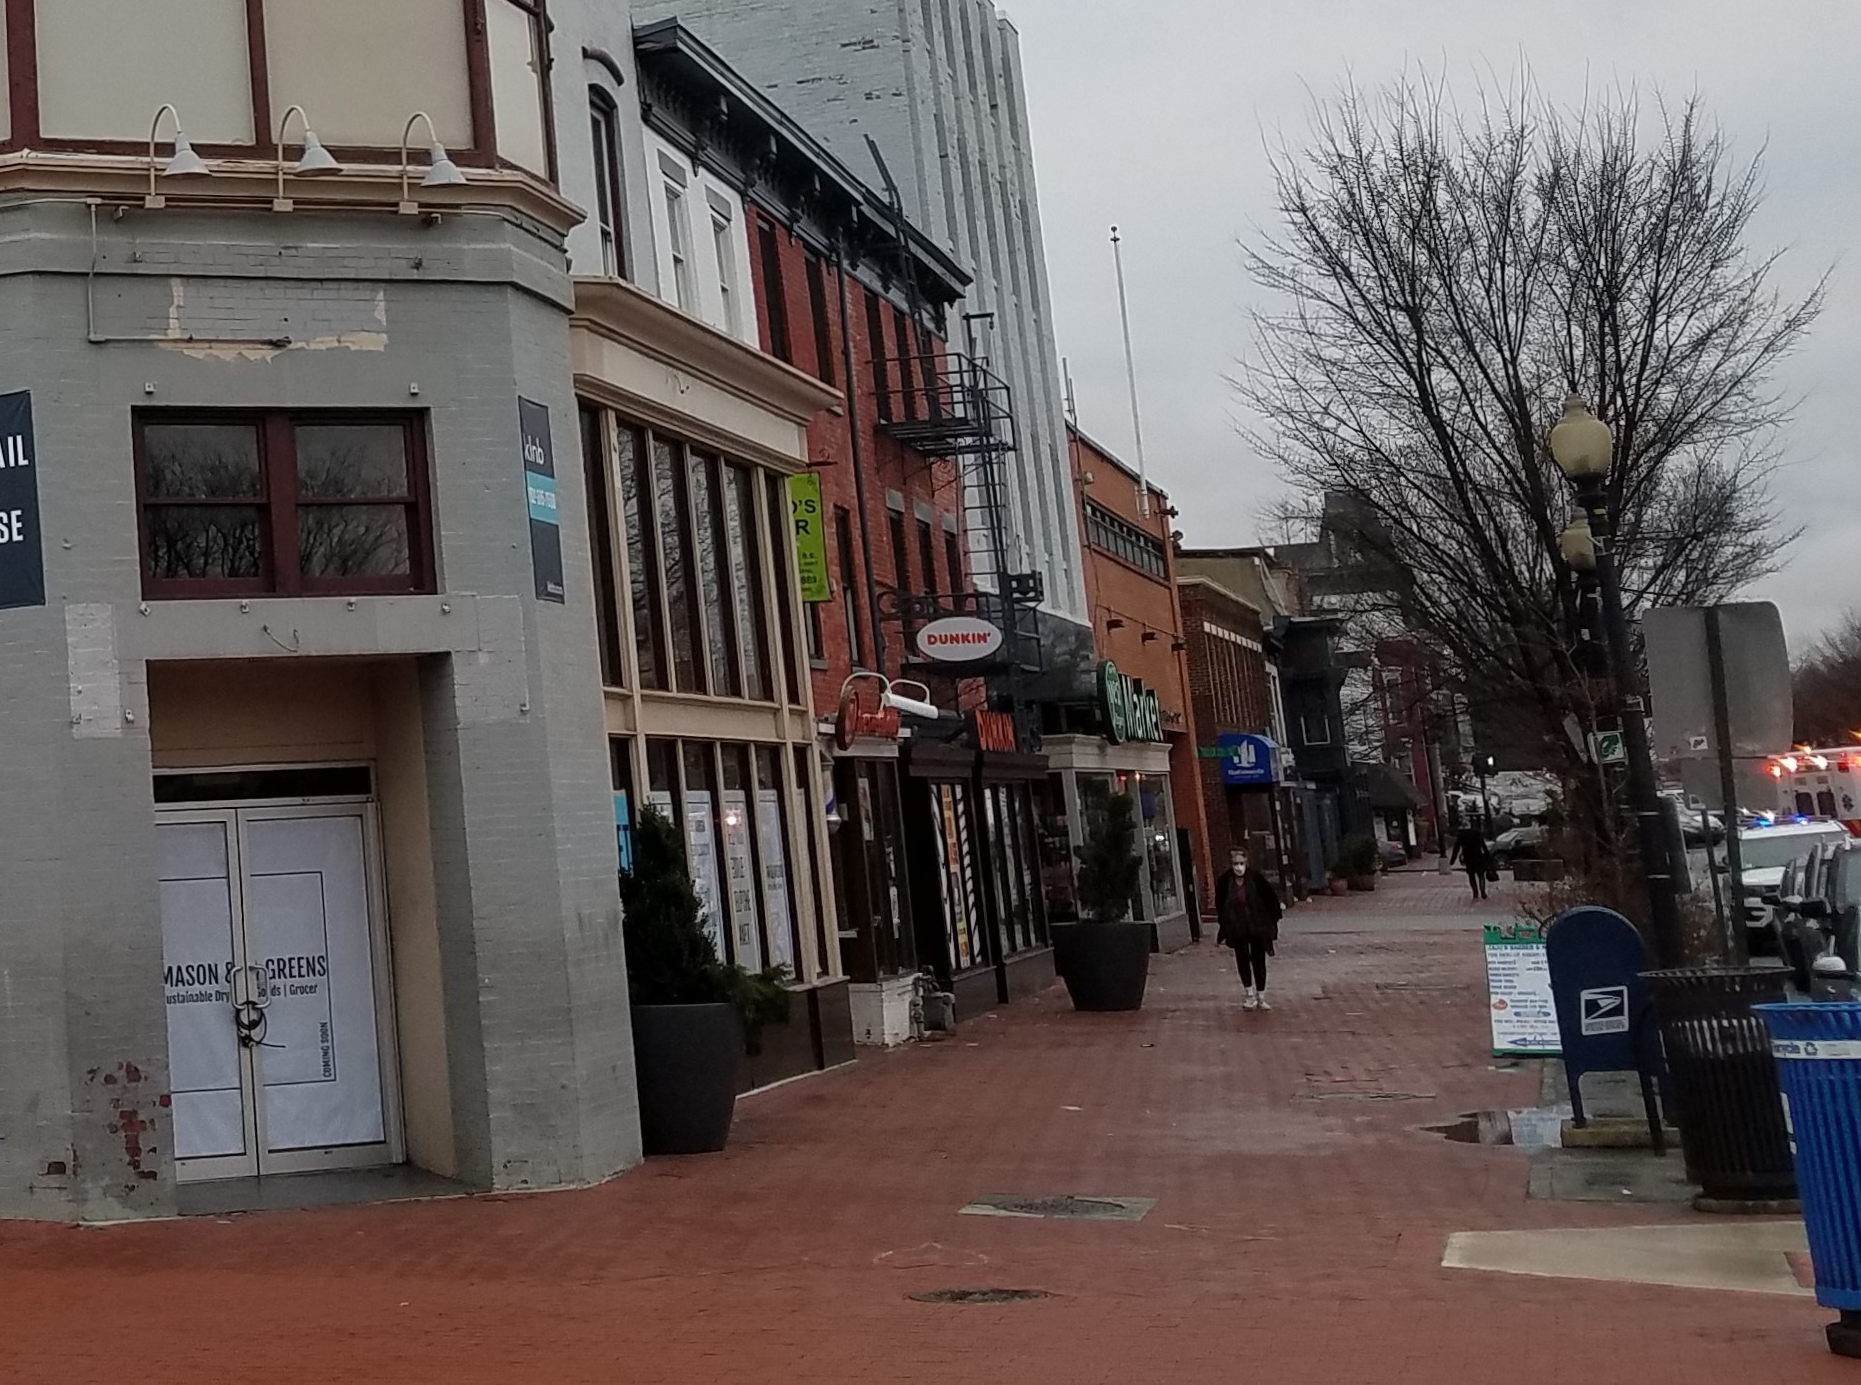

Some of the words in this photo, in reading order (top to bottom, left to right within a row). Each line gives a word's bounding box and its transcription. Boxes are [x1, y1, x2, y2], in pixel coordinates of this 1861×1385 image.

[926, 632, 991, 646] DUNKIN'
[1121, 674, 1164, 742] Market
[164, 963, 218, 987] MASON
[266, 955, 326, 980] GREENS
[166, 990, 213, 1005] ustainable
[215, 989, 229, 1004] Dry
[289, 983, 318, 995] Grocer
[320, 1022, 329, 1044] SOON
[320, 1045, 332, 1078] COMING
